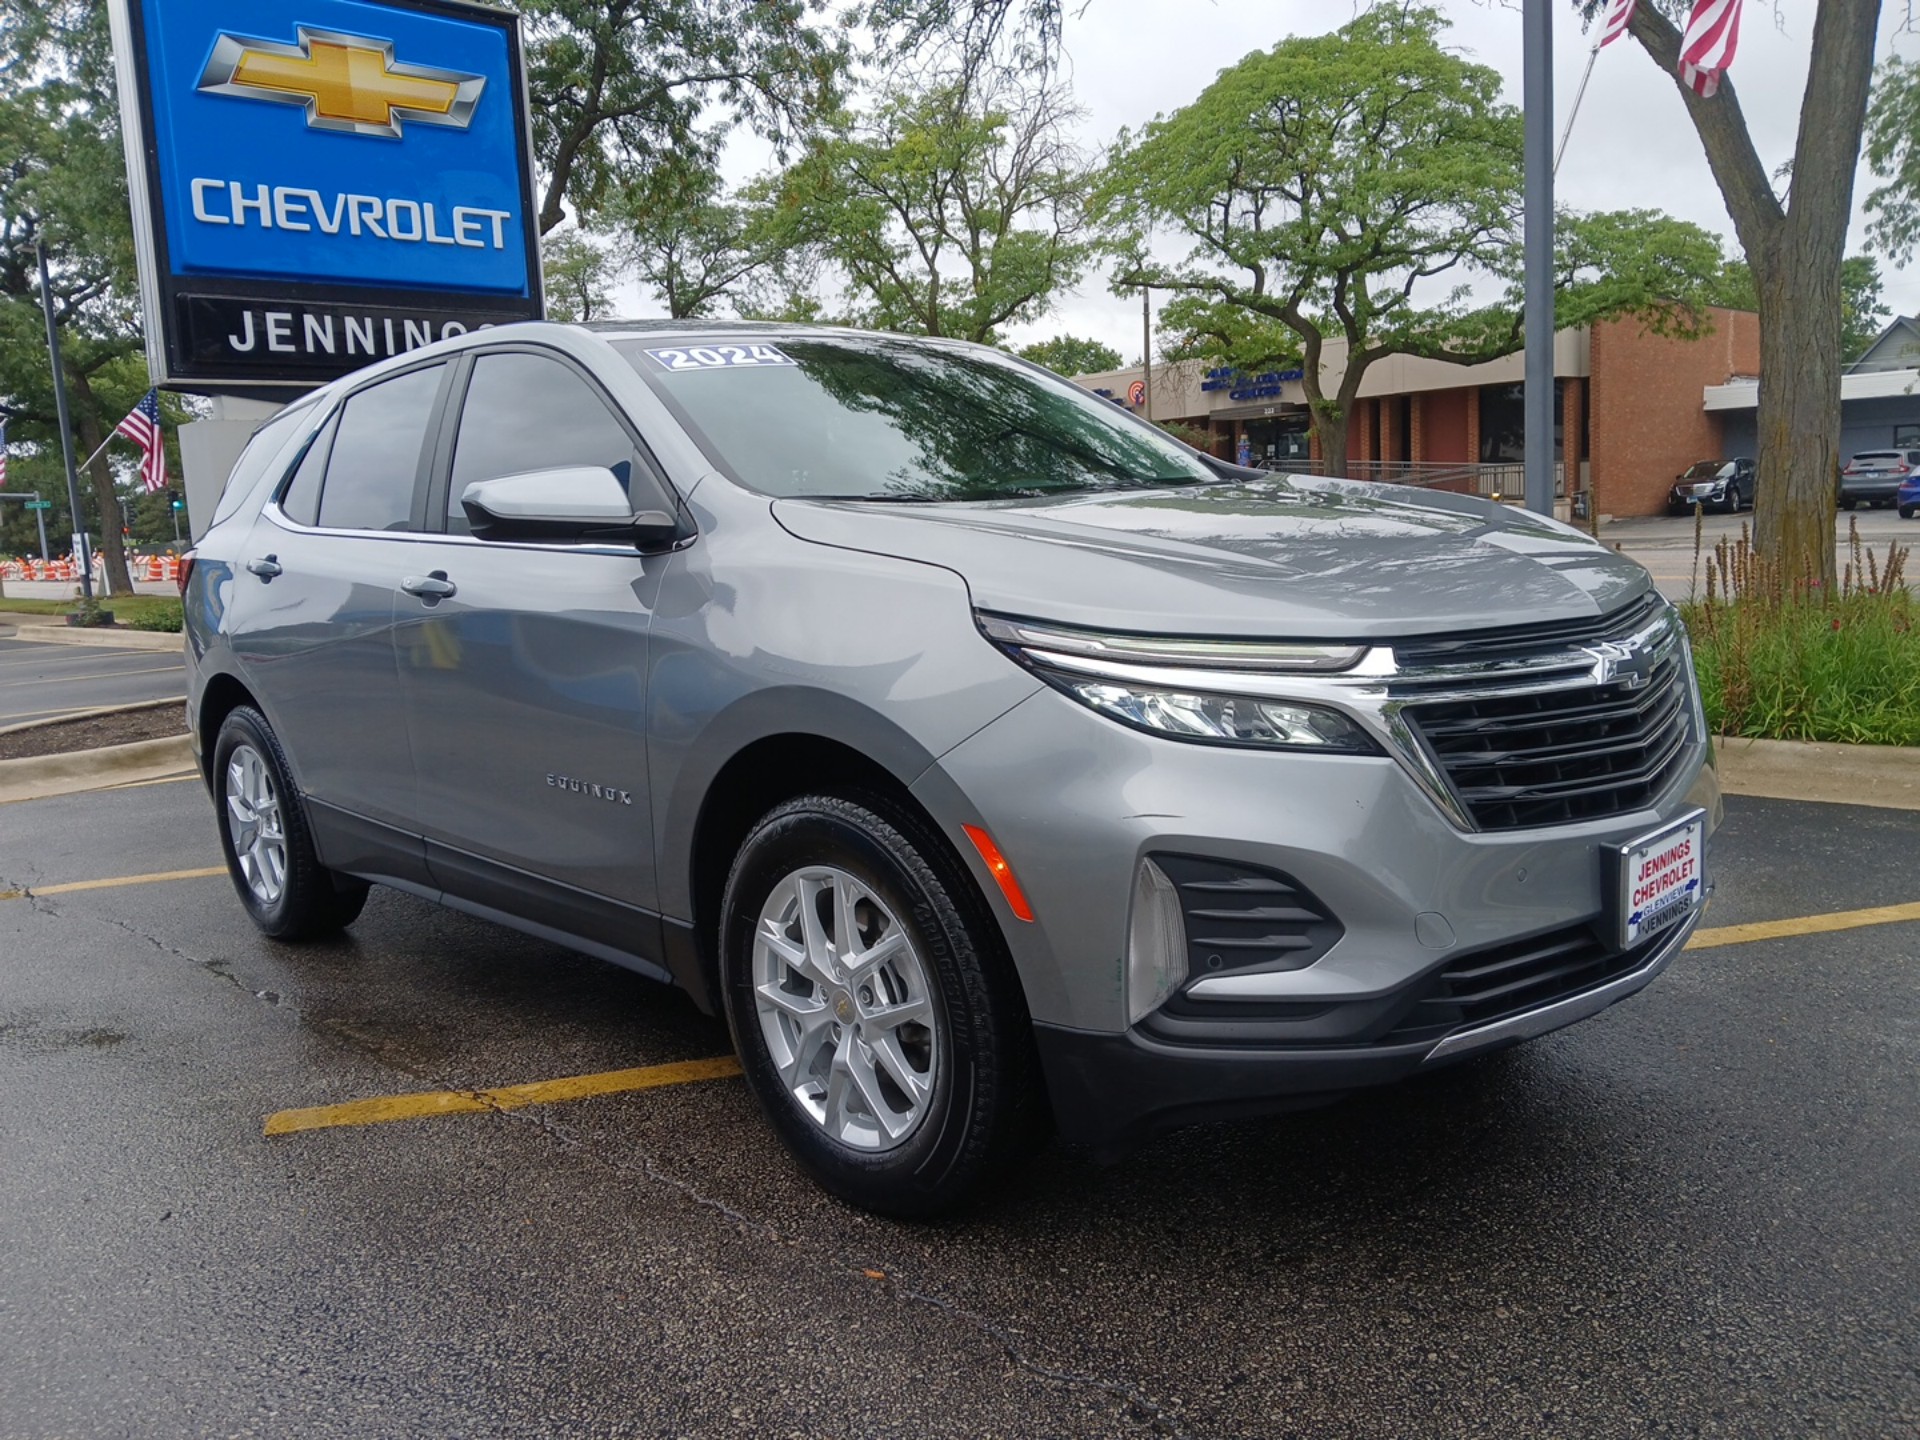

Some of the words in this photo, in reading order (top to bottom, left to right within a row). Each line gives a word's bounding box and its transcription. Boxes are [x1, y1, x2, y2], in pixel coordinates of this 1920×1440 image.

[191, 177, 511, 249] CHEVROLET
[229, 310, 499, 356] JENNIN
[658, 345, 785, 369] 2024
[546, 773, 632, 805] EQUINOX
[1638, 838, 1691, 883] JENNINGS
[1633, 858, 1695, 907] CHEVROLET
[1643, 884, 1686, 917] GLENVIEW
[1644, 897, 1689, 934] JENNINGS
